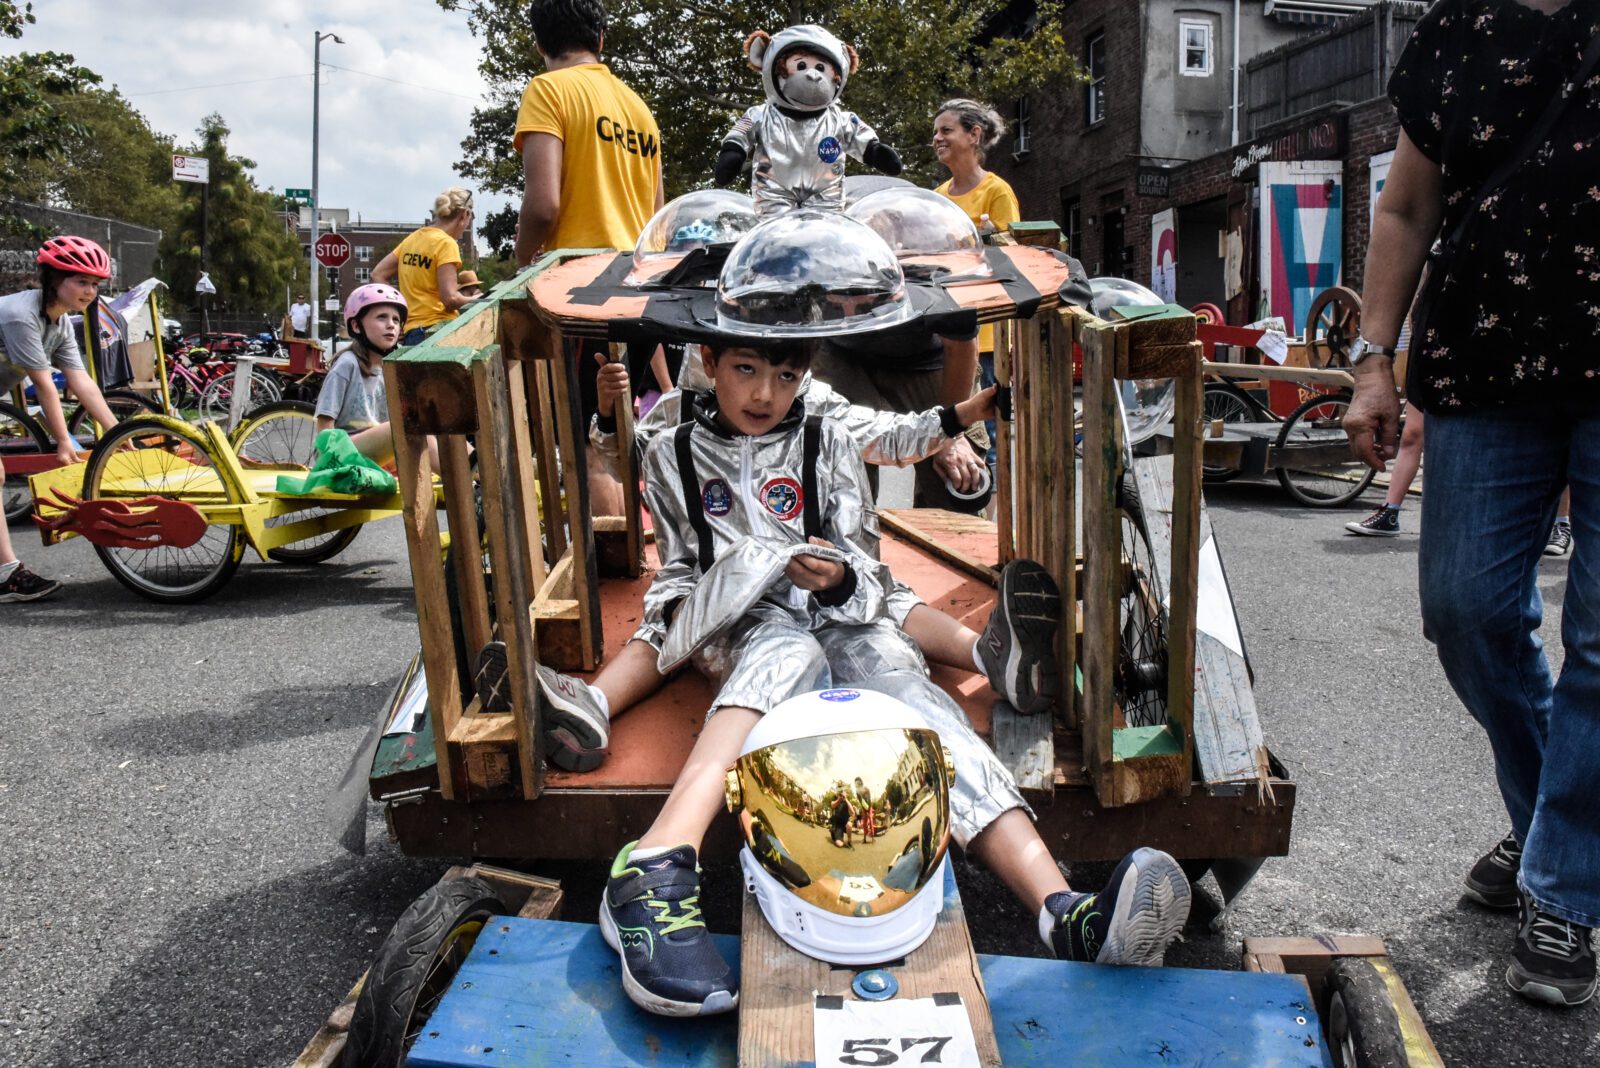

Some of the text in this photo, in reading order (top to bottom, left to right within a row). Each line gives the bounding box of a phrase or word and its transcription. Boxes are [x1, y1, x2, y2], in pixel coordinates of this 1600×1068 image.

[597, 115, 658, 160] CREW
[819, 147, 839, 155] NASA
[1140, 174, 1168, 187] OPEN
[316, 243, 348, 257] STOP
[402, 252, 433, 270] CREW
[838, 1036, 953, 1066] 57
